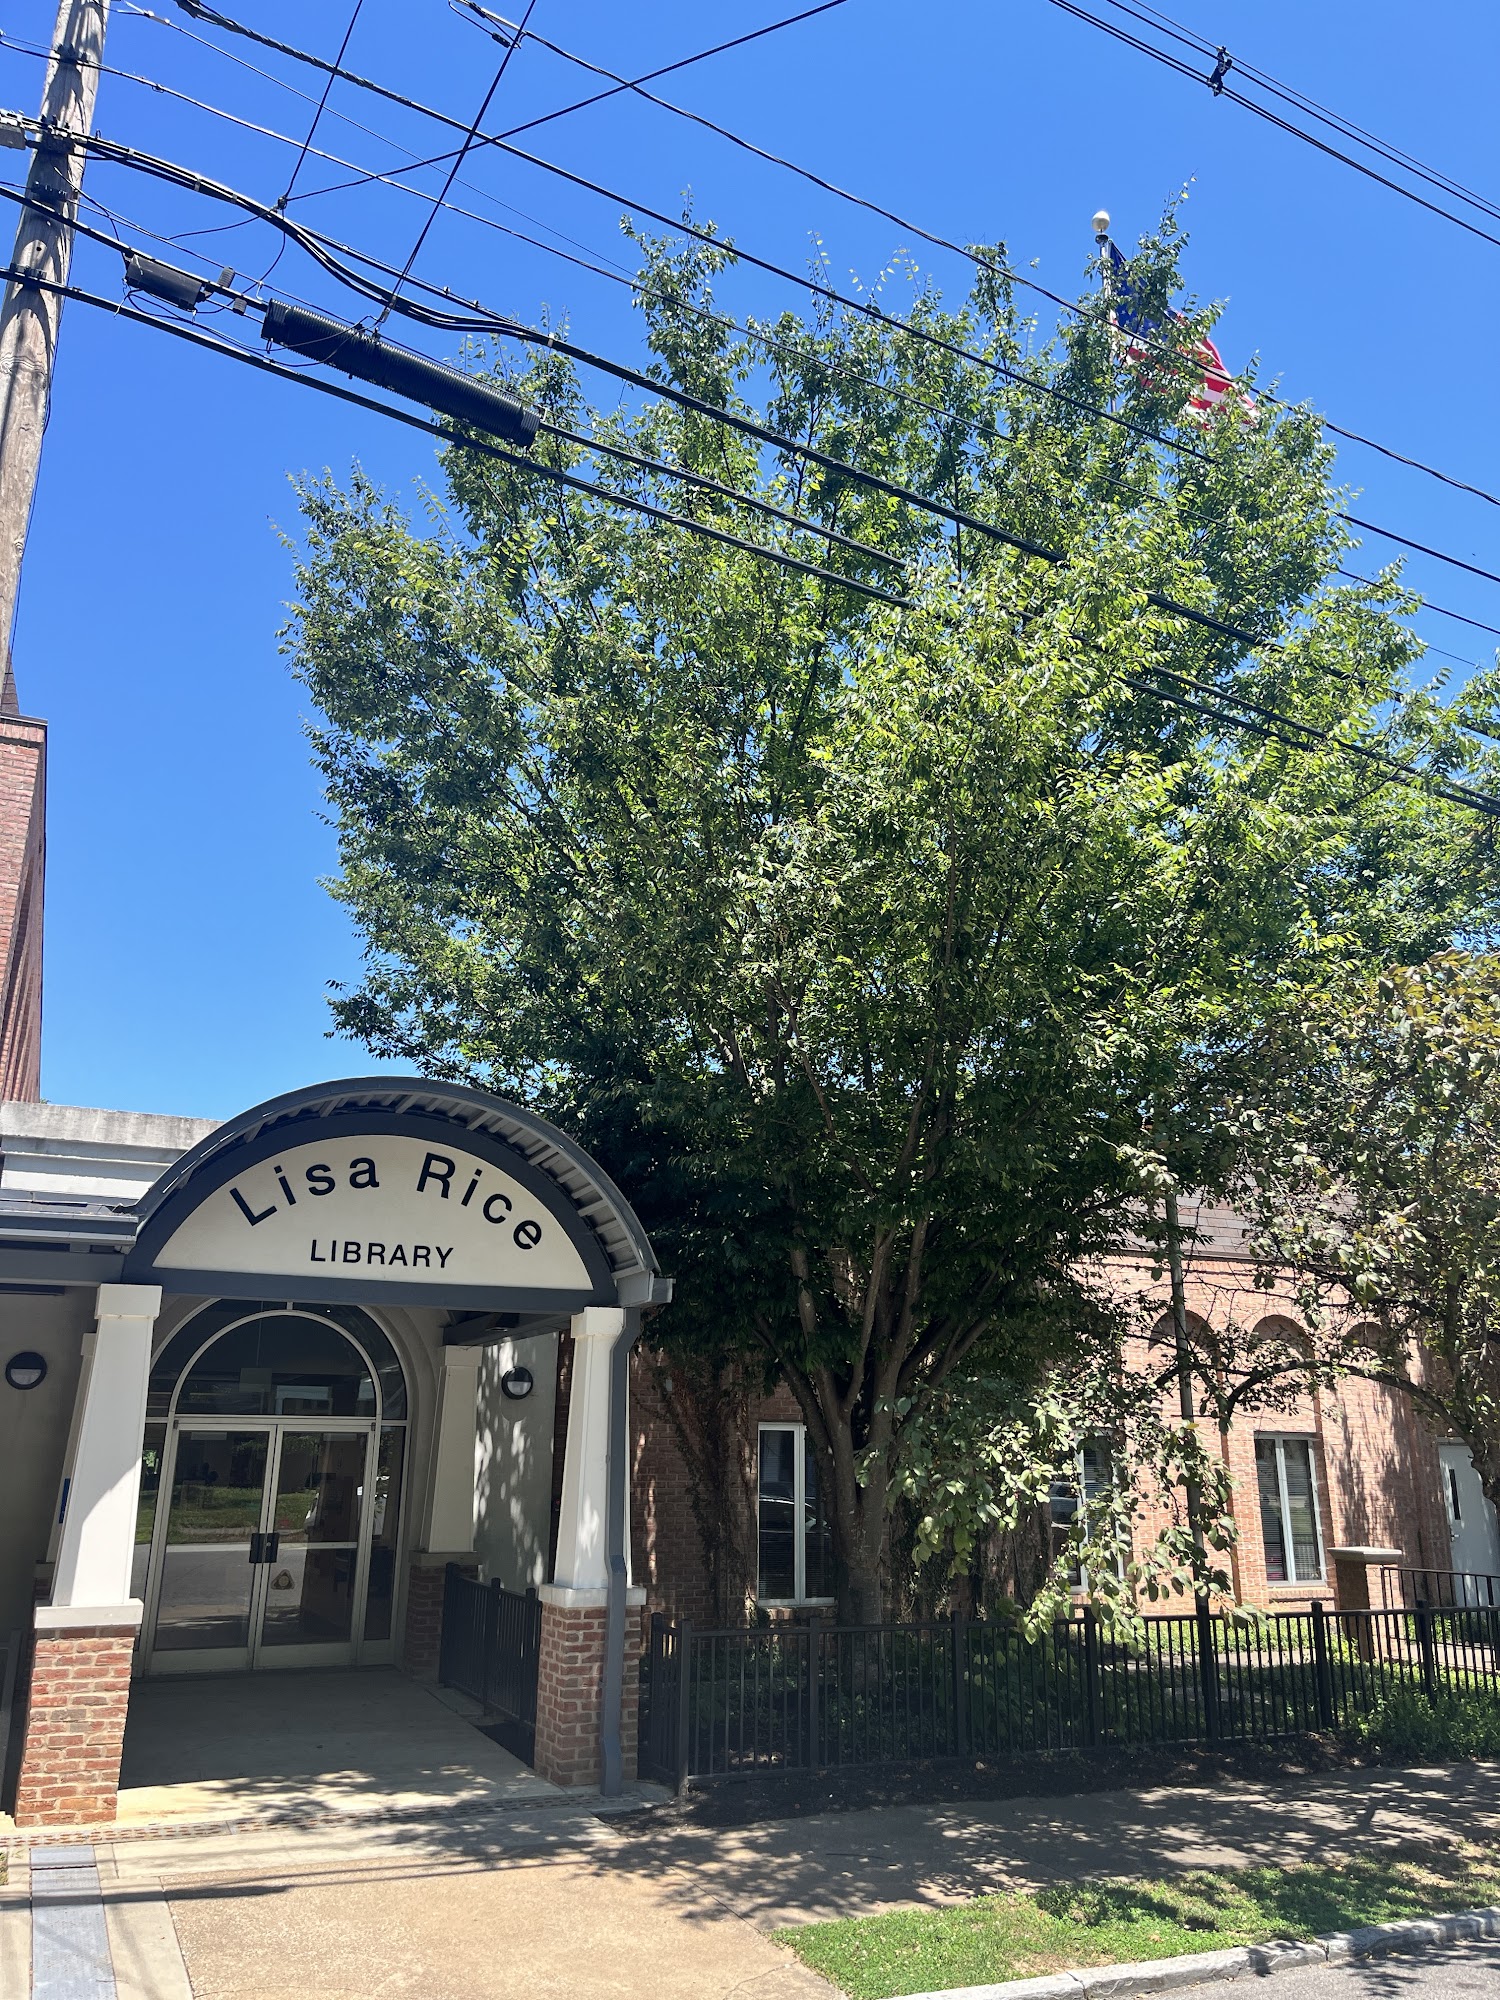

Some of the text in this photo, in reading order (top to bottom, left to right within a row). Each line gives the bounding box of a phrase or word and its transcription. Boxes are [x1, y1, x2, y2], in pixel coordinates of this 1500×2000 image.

[228, 1151, 543, 1250] Lisa Rice
[310, 1239, 454, 1269] LIBRARY
